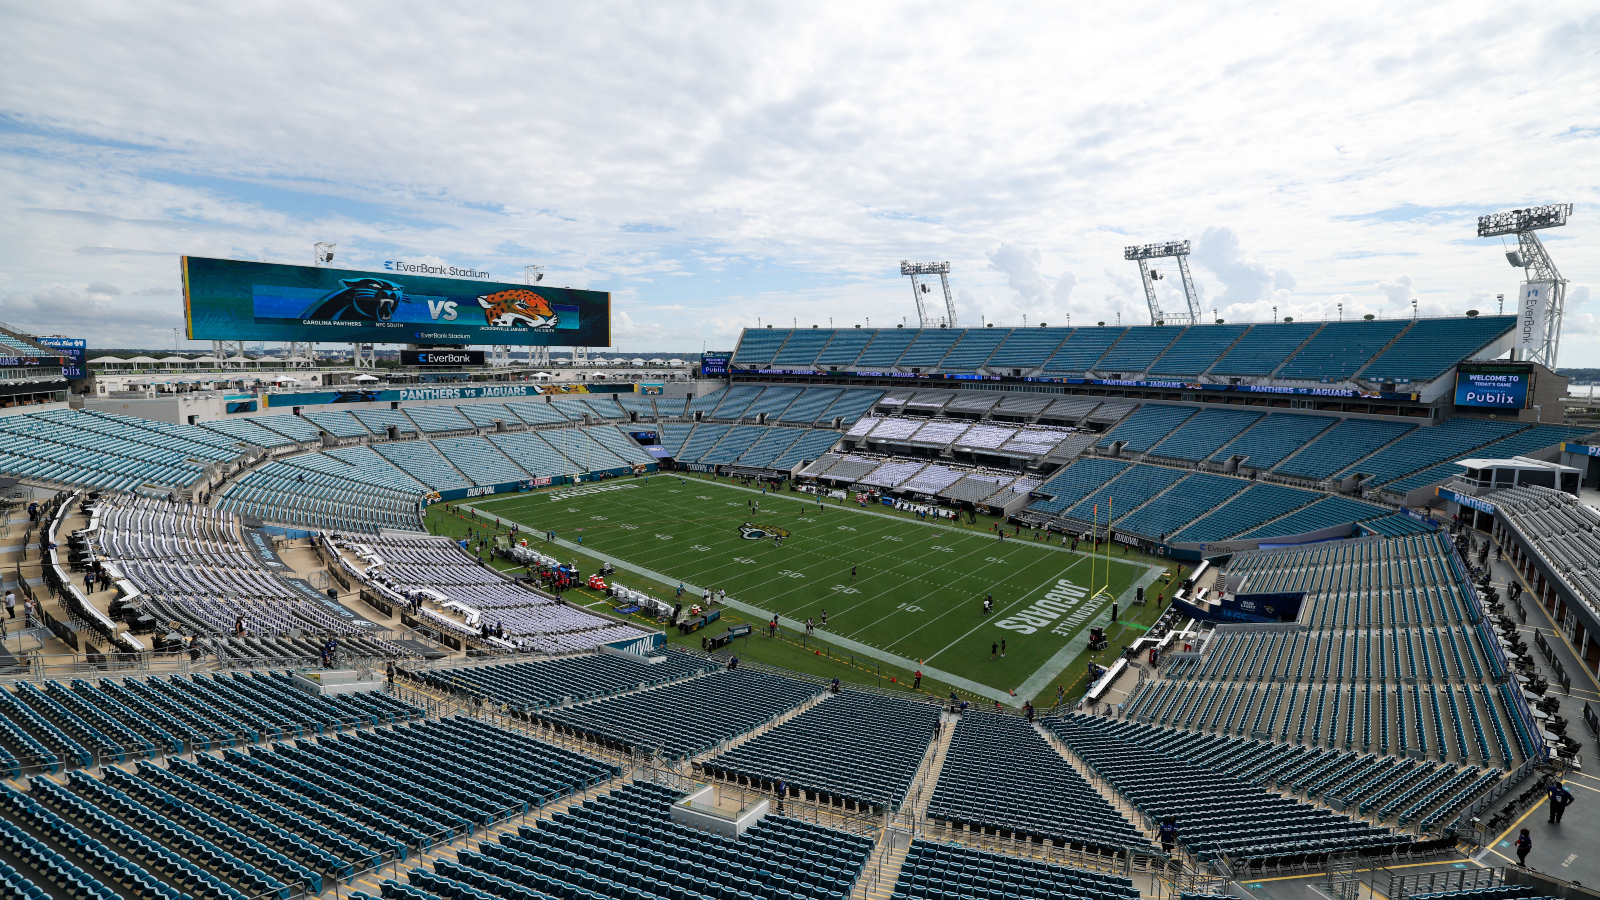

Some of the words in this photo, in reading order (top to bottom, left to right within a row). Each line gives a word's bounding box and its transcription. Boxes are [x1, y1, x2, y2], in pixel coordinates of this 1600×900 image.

[396, 261, 447, 275] EverBank
[449, 266, 490, 279] Stadium
[427, 299, 458, 321] VS
[1522, 299, 1537, 344] EverBank
[428, 353, 470, 364] EverBank
[62, 366, 81, 376] blix
[1469, 374, 1507, 382] WELCOME
[399, 388, 460, 401] PANTHERS
[464, 389, 476, 397] VS
[480, 386, 527, 397] JAGUARS
[1250, 385, 1294, 394] PANTHERS
[1310, 388, 1353, 397] JAGUARS
[1466, 391, 1514, 404] Publix
[993, 578, 1090, 635] JAGUARS
